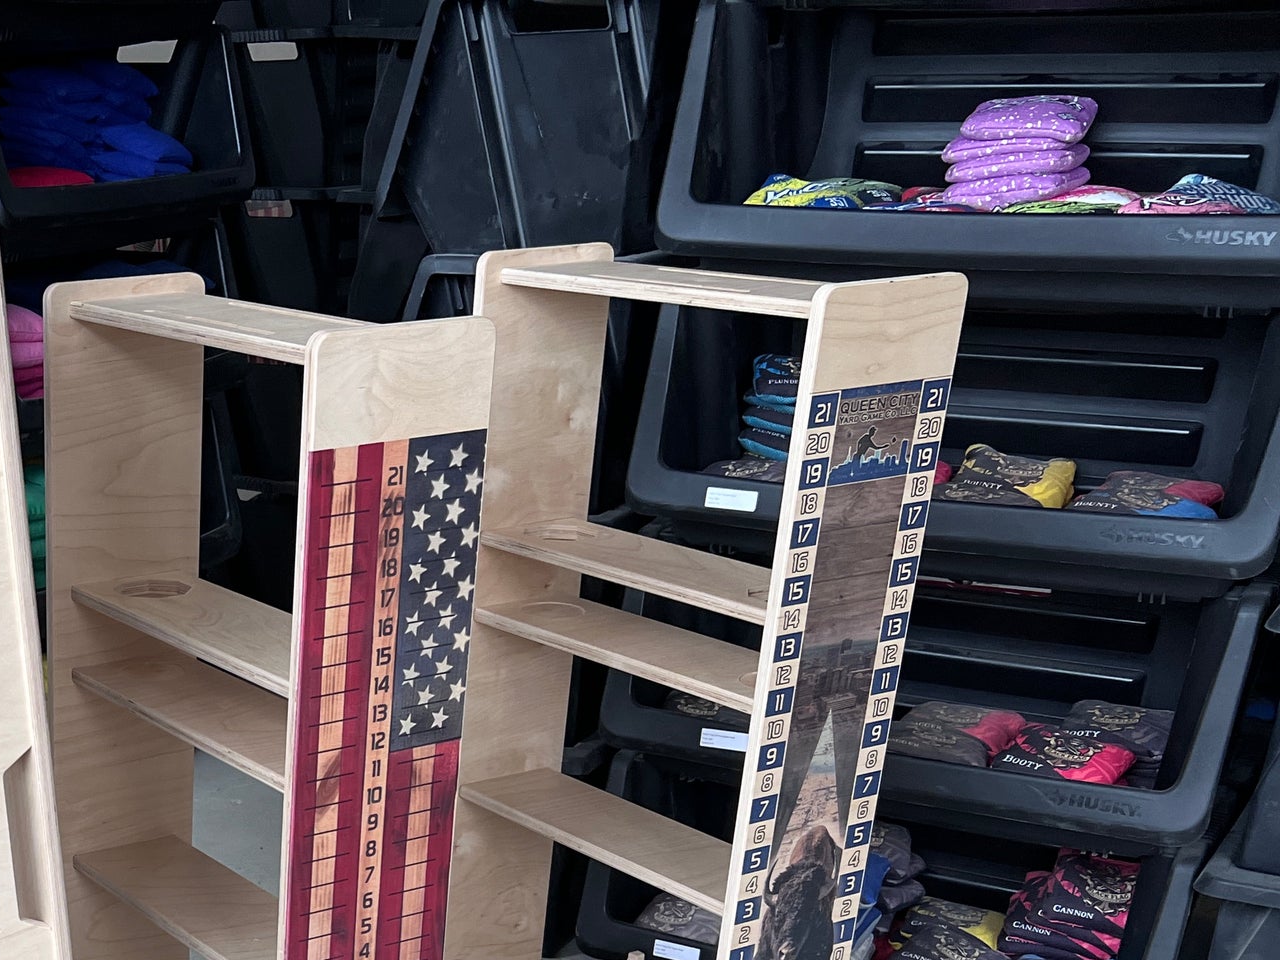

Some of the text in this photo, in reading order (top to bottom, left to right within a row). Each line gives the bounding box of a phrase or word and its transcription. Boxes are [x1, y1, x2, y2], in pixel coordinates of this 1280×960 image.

[1194, 229, 1278, 246] HUSKY
[841, 392, 920, 414] QUEEN CITY
[927, 388, 943, 408] 21
[815, 402, 831, 423] 21
[839, 414, 859, 425] YARD
[860, 412, 883, 422] GAME
[900, 405, 918, 415] LLC
[917, 416, 942, 440] 20
[805, 432, 831, 456] 20
[917, 448, 932, 467] 19
[387, 465, 404, 486] 21
[806, 464, 822, 484] 19
[963, 479, 1002, 490] BOUNTY
[1073, 501, 1118, 510] BOUNTY
[907, 506, 922, 525] 17
[384, 527, 400, 548] 19
[798, 523, 813, 543] 17
[1129, 529, 1205, 548] HUSKY
[897, 562, 912, 582] 15
[381, 587, 395, 608] 17
[788, 581, 804, 601] 15
[887, 618, 902, 636] 13
[376, 646, 391, 666] 15
[780, 638, 795, 657] 13
[881, 672, 890, 689] 11
[775, 694, 785, 711] 11
[372, 704, 388, 723] 13
[371, 732, 386, 751] 12
[871, 725, 882, 742] 9
[766, 748, 777, 765] 9
[1002, 754, 1043, 771] BOOTY
[862, 776, 873, 793] 7
[367, 786, 382, 805] 10
[759, 800, 769, 817] 7
[1071, 795, 1138, 817] HUSKY
[367, 813, 378, 831] 9
[853, 826, 864, 843] 5
[750, 851, 762, 869] 5
[365, 866, 375, 884] 7
[845, 876, 855, 892] 3
[743, 902, 754, 918] 3
[1052, 904, 1094, 920] CANNON
[360, 917, 372, 935] 5
[840, 924, 845, 939] 1
[1012, 921, 1051, 936] CANNON
